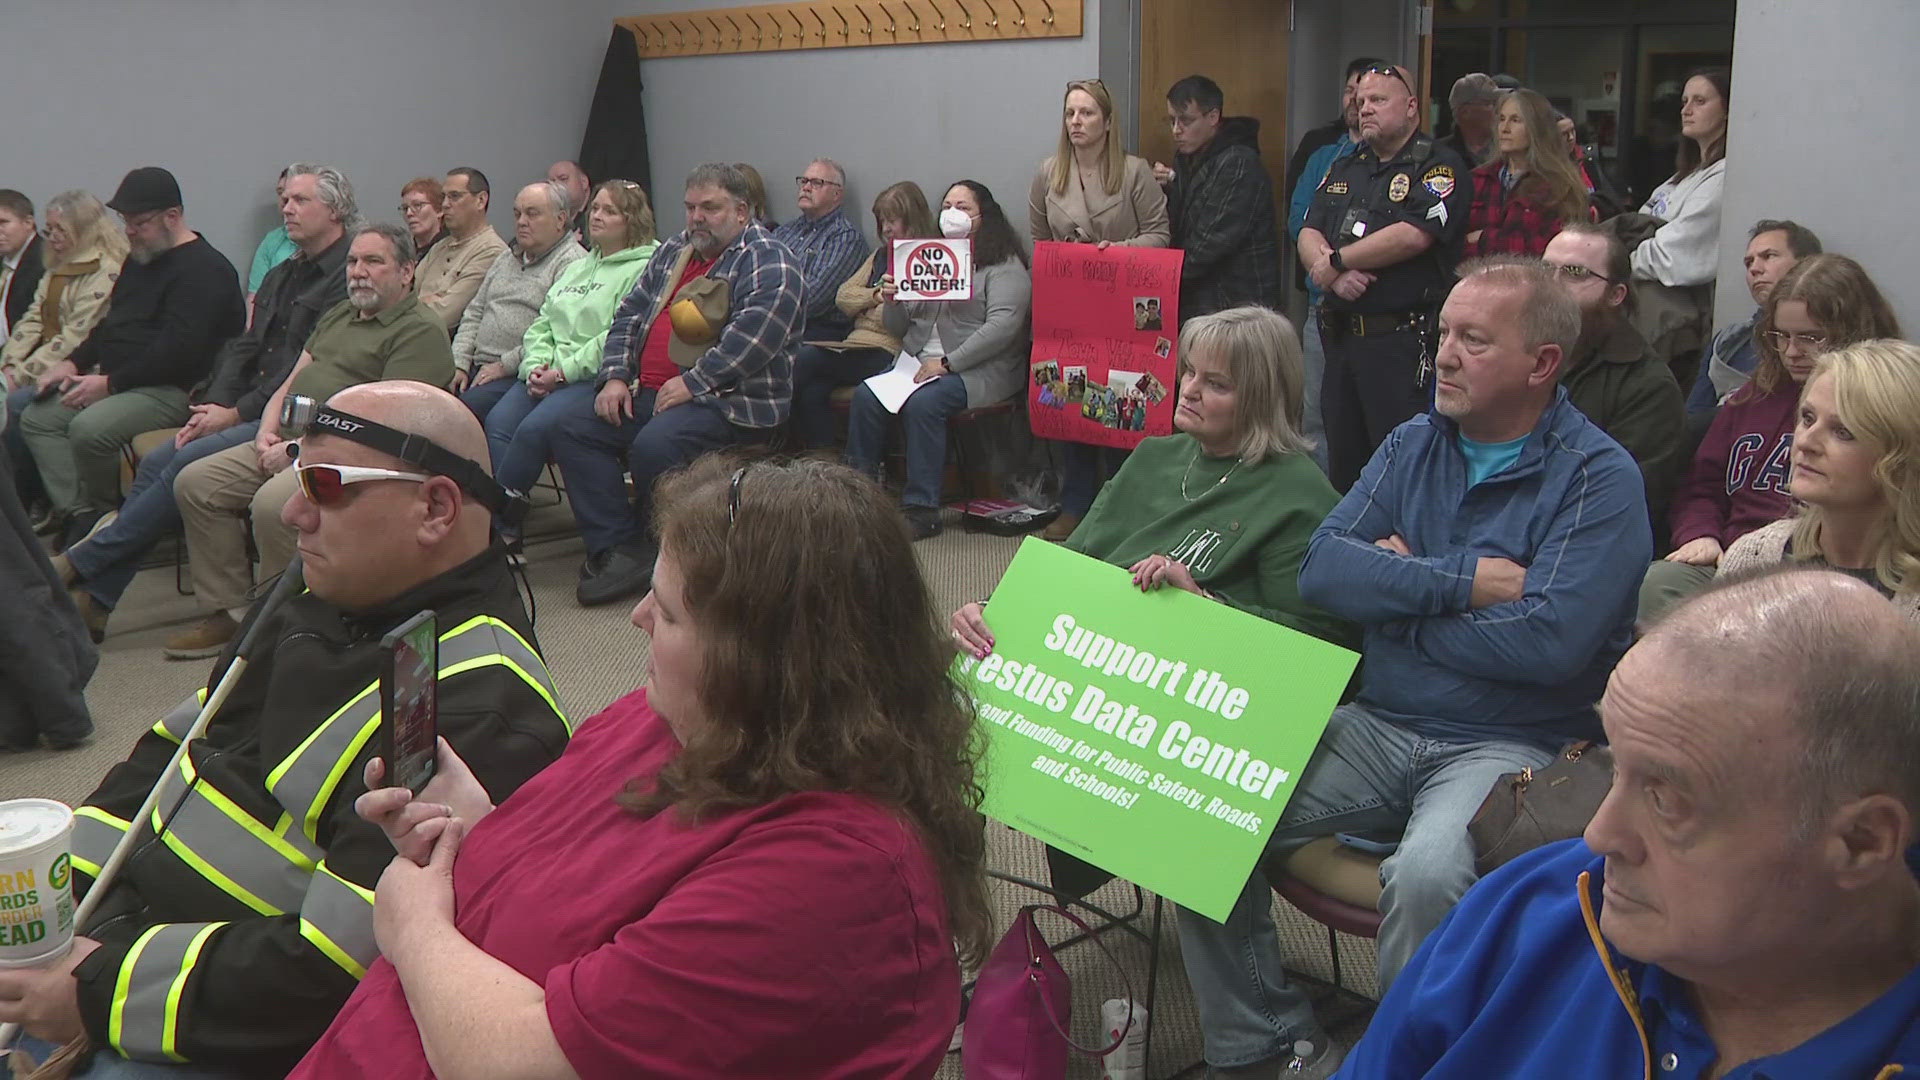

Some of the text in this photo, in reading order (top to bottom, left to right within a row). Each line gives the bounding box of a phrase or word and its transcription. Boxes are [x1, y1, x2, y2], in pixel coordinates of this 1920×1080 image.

[1423, 166, 1454, 180] POLICE
[921, 248, 944, 261] NO
[913, 263, 952, 276] DATA
[1040, 243, 1073, 279] The
[1082, 258, 1119, 293] many
[900, 278, 965, 292] CENTER!
[317, 413, 365, 432] OAST
[1726, 432, 1795, 496] GA
[1044, 613, 1250, 720] Support the
[1070, 684, 1158, 749] Data
[1157, 720, 1290, 801] Center
[980, 703, 1262, 836] and Funding for Public Safety, Roads,
[1031, 755, 1140, 810] and Schools!
[0, 868, 36, 894] RN
[0, 889, 39, 910] RDS
[0, 904, 43, 925] RDER
[0, 919, 46, 946] EAD
